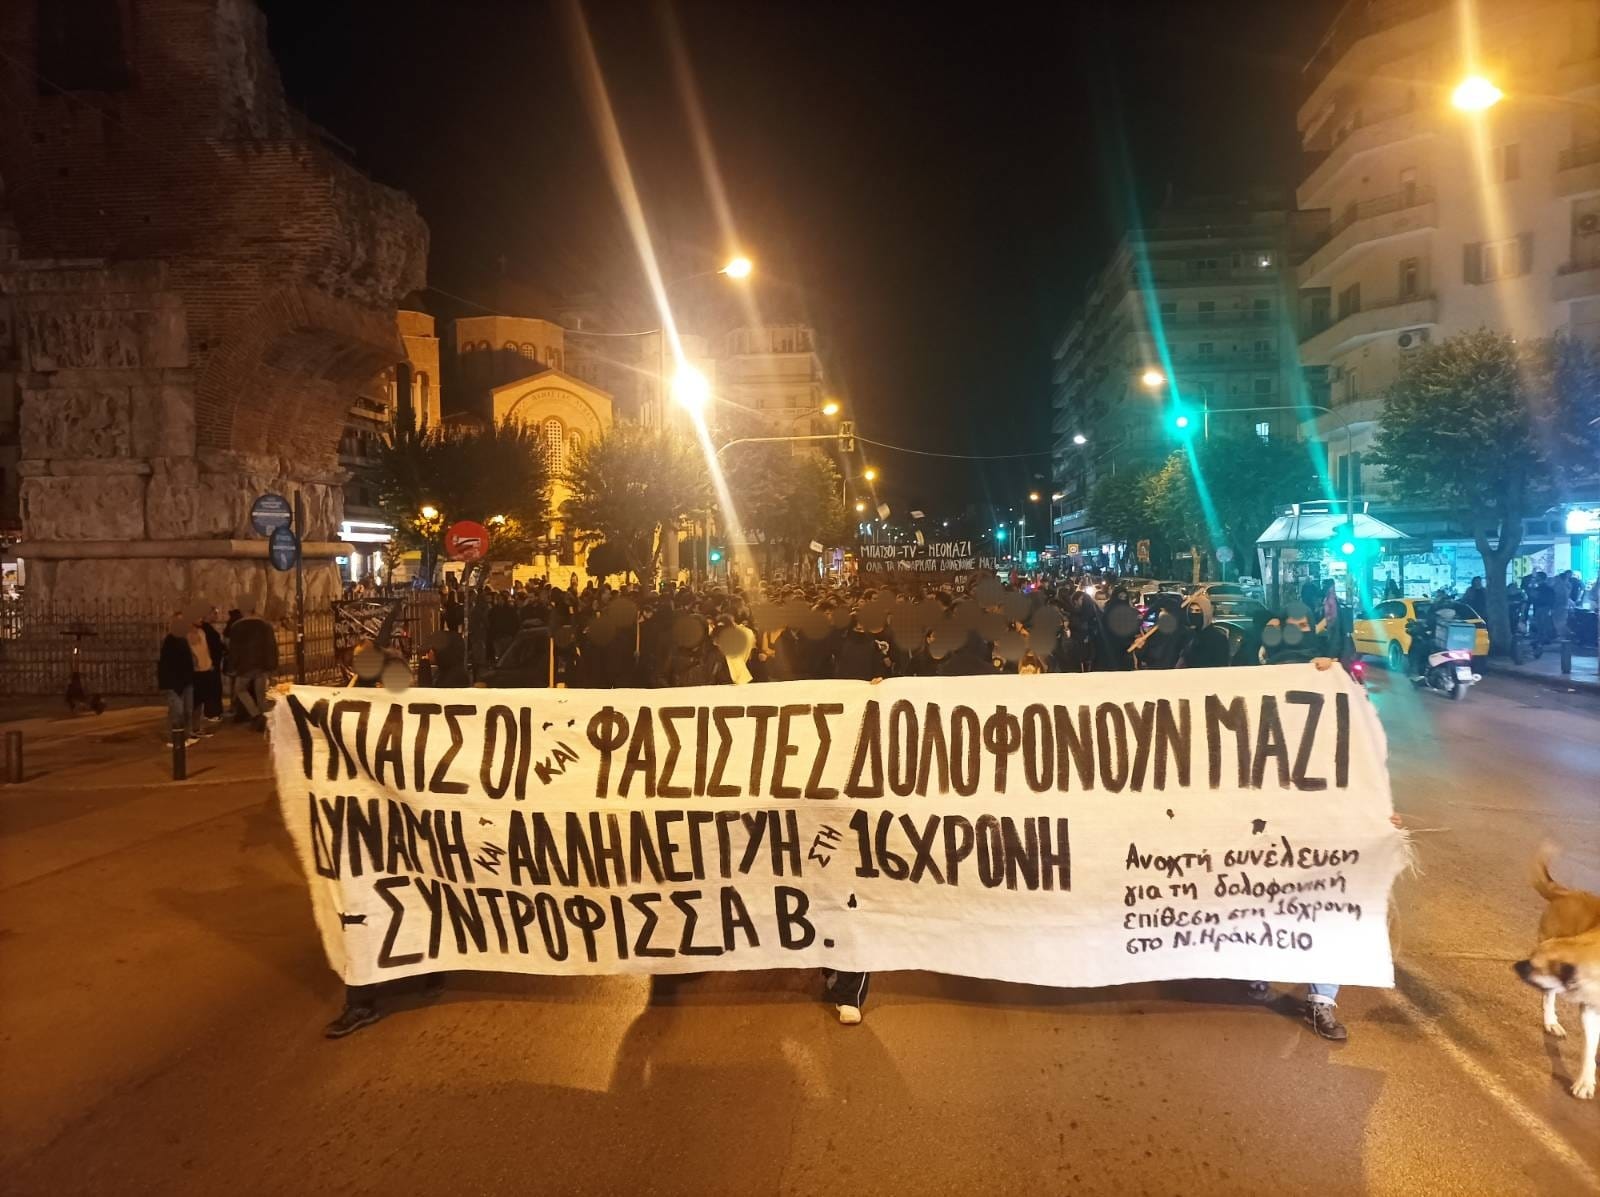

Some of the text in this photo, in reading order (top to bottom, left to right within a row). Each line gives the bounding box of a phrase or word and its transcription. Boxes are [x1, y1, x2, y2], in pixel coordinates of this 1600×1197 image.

[860, 545, 896, 559] ΜΠΑΤΣΟΙ
[286, 690, 1350, 801] ΜΠΑΤΣΟΙ ΚΑΙ ΦΑΣΙΣΤΕΣ ΔΟΛΟΦΟΝΟΥΝ ΜΑΖΙ
[309, 791, 1072, 892] ΔΥΝΑΜΗ ΚΑΙ ΑΛΛΗΛΕΓΓΥΗ ΣΤΗ 16ΧΡΟΝΗ
[1224, 836, 1360, 869] συνέλευση
[1124, 872, 1347, 907] για τη δολοφονική
[373, 875, 835, 969] ΣΥΝΤΡΟΦΙΣΣΑ Β.
[1123, 906, 1221, 930] επίθεση
[1274, 896, 1363, 923] 16χρονη
[1126, 937, 1163, 955] στο
